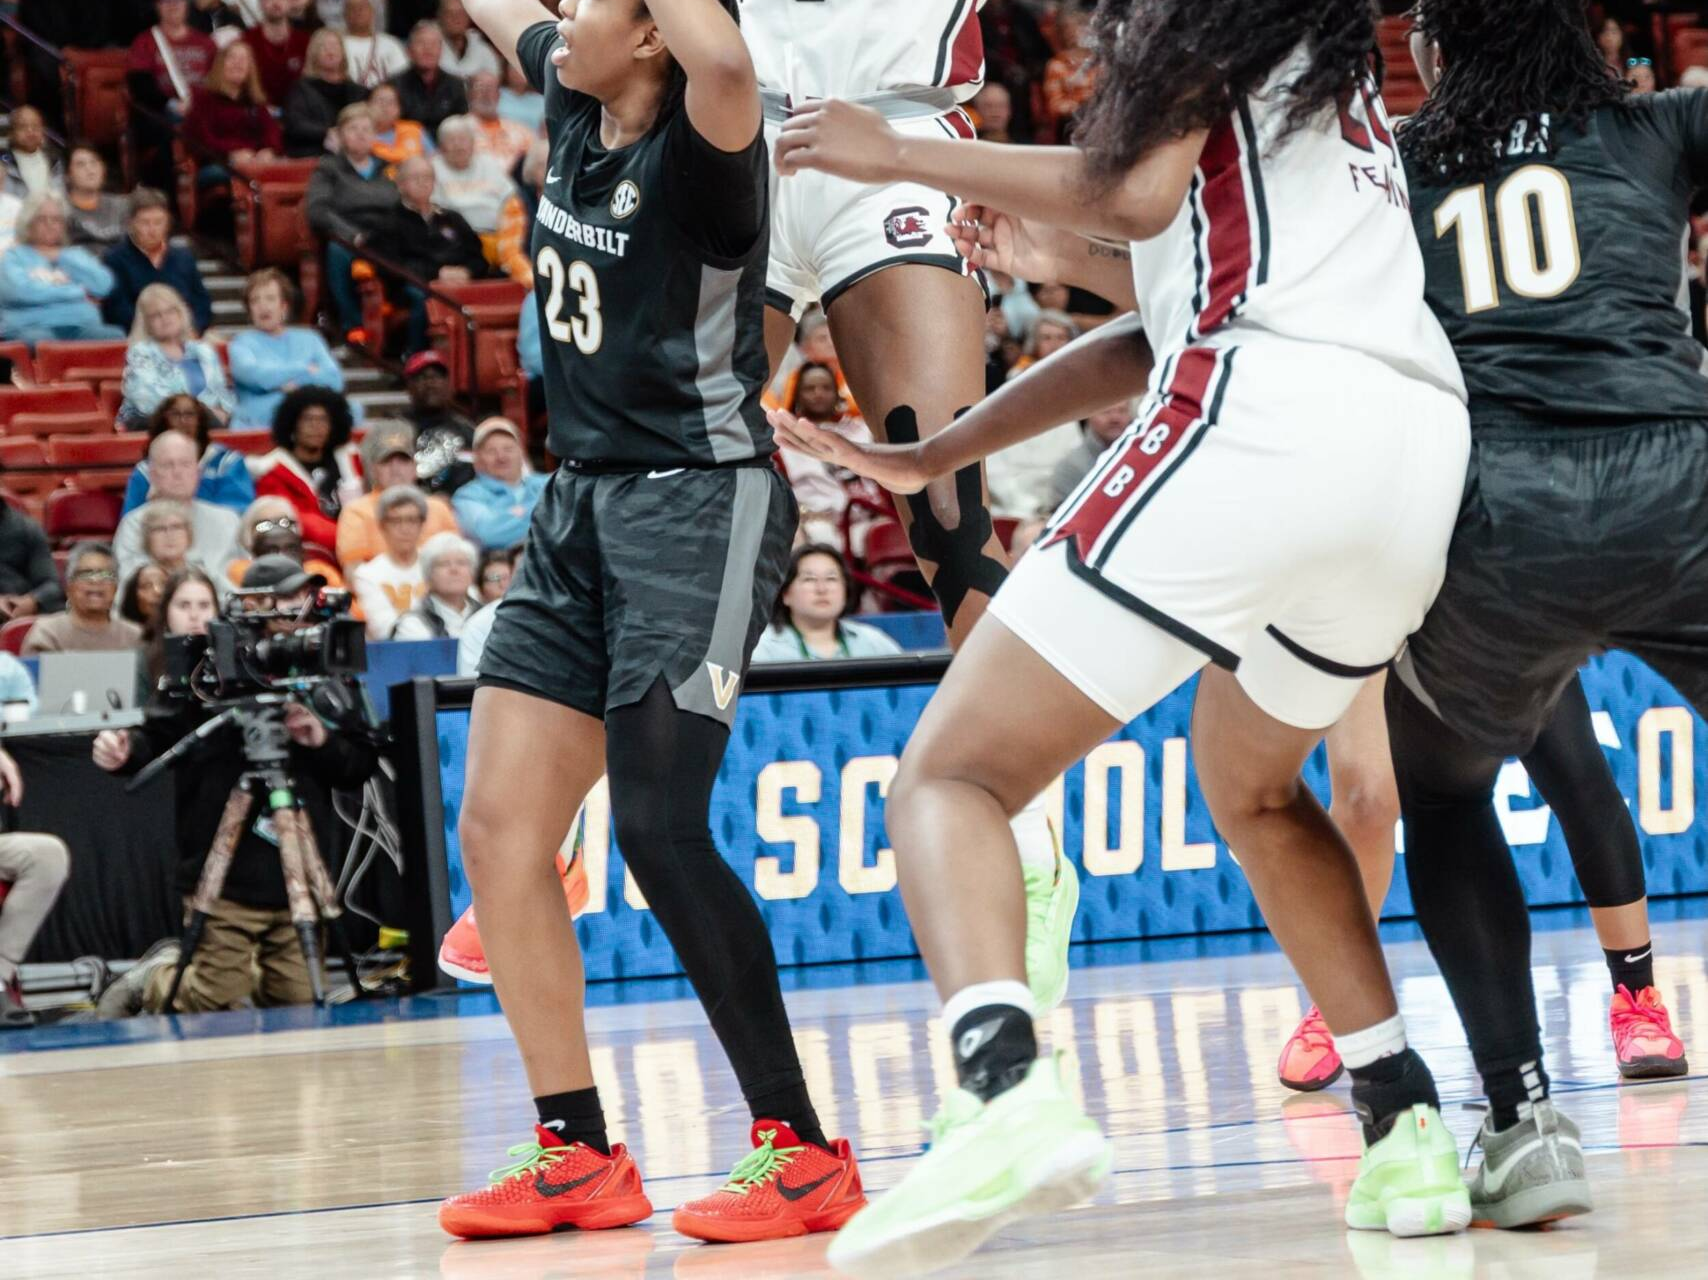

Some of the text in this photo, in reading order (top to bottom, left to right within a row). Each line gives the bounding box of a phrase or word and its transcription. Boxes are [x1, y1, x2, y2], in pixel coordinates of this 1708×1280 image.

[613, 182, 637, 216] SEC
[1433, 164, 1581, 315] 10
[536, 245, 604, 355] 23
